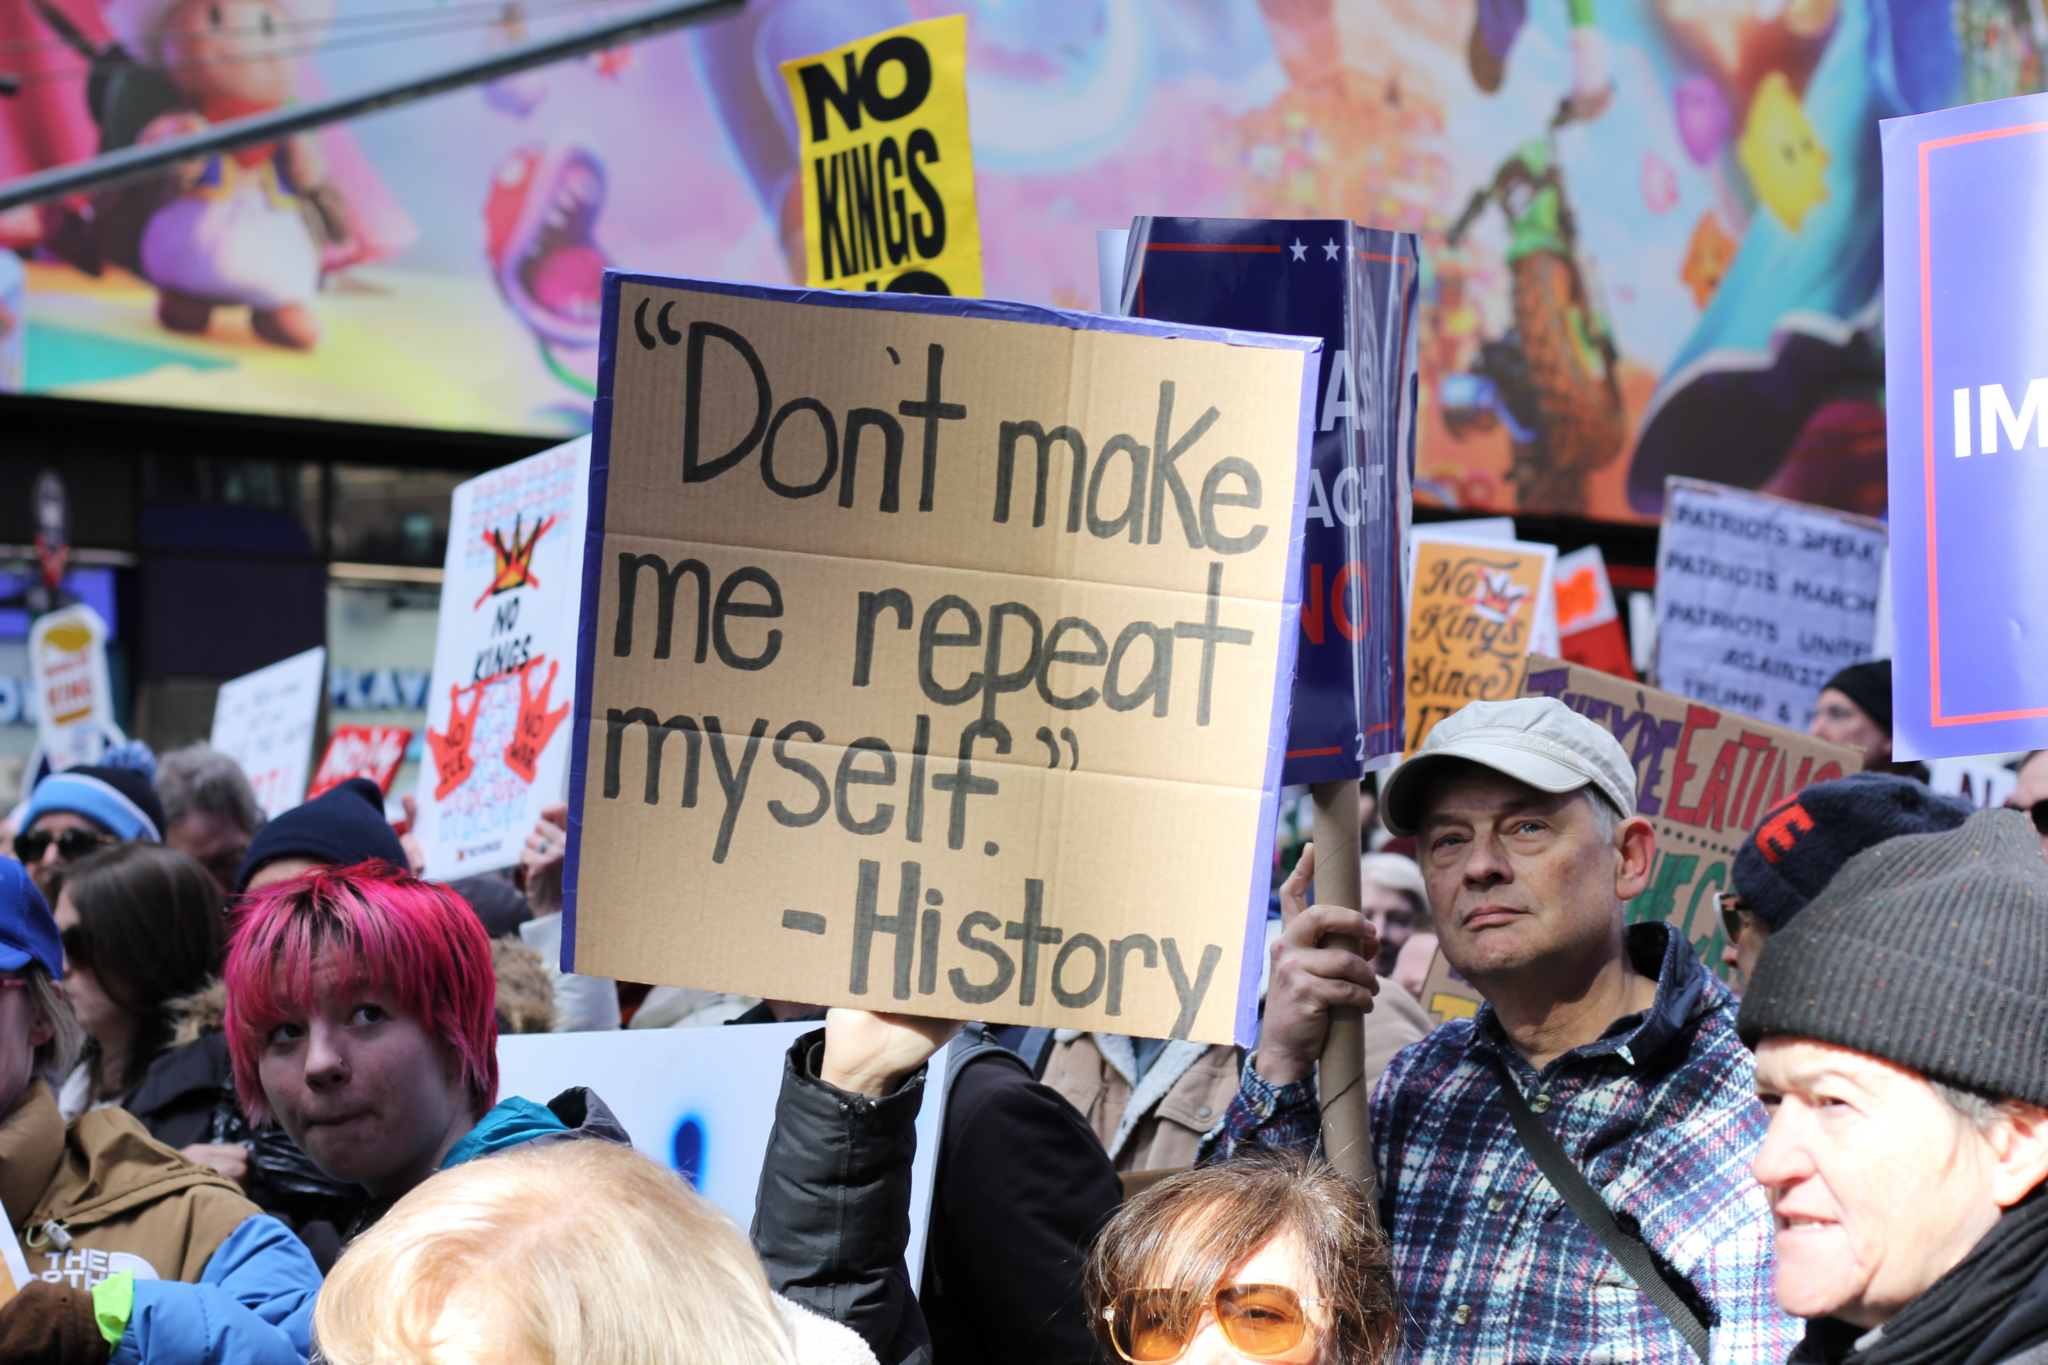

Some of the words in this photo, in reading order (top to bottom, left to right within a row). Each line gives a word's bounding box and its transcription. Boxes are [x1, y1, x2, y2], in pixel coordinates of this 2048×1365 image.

[797, 36, 933, 143] NO
[814, 128, 947, 282] KINGS
[993, 380, 1268, 555] make
[1676, 504, 1788, 547] PATRIOTS
[1800, 528, 1876, 560] SPEAK
[1667, 551, 1779, 594] PATRIOTS
[1793, 578, 1877, 616] MARCH
[492, 597, 520, 637] NO
[614, 551, 784, 672] me
[853, 561, 1254, 726] repeat
[1410, 603, 1524, 661] Kings
[1667, 602, 1780, 642] PATRIOTS
[473, 634, 532, 682] KINGS
[1408, 655, 1514, 701] Since
[1723, 648, 1827, 686] AGAINST
[1682, 677, 1767, 712] TRUMP
[1664, 704, 1843, 834] EATIN
[849, 859, 1223, 1041] History
[44, 1247, 108, 1273] THE
